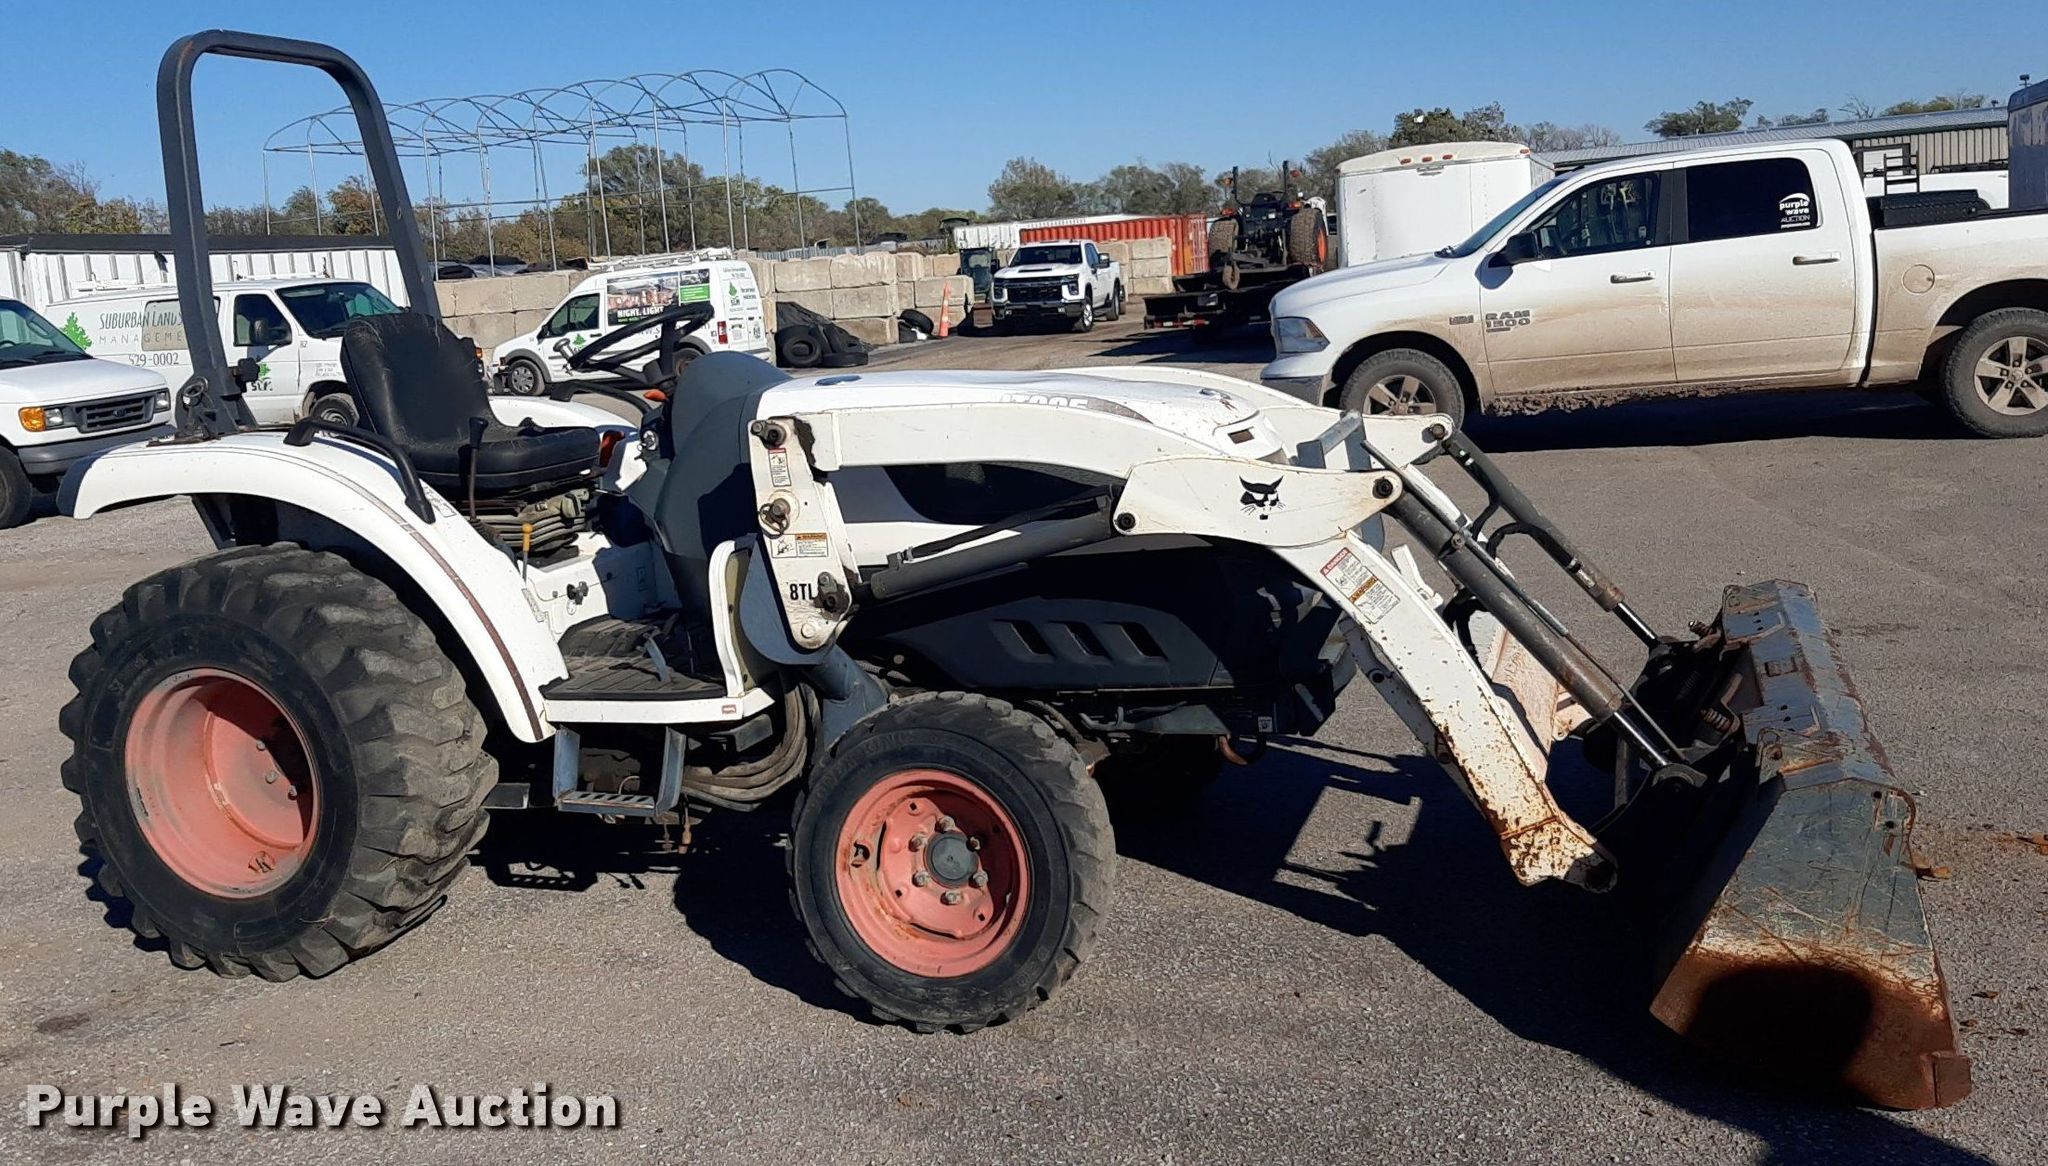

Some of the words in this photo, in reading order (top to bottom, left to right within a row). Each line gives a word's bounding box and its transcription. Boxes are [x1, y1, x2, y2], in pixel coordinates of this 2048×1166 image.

[1779, 200, 1809, 210] purple
[1485, 309, 1531, 320] RAM
[99, 311, 150, 330] SUBURBAN
[1485, 318, 1531, 328] 1500
